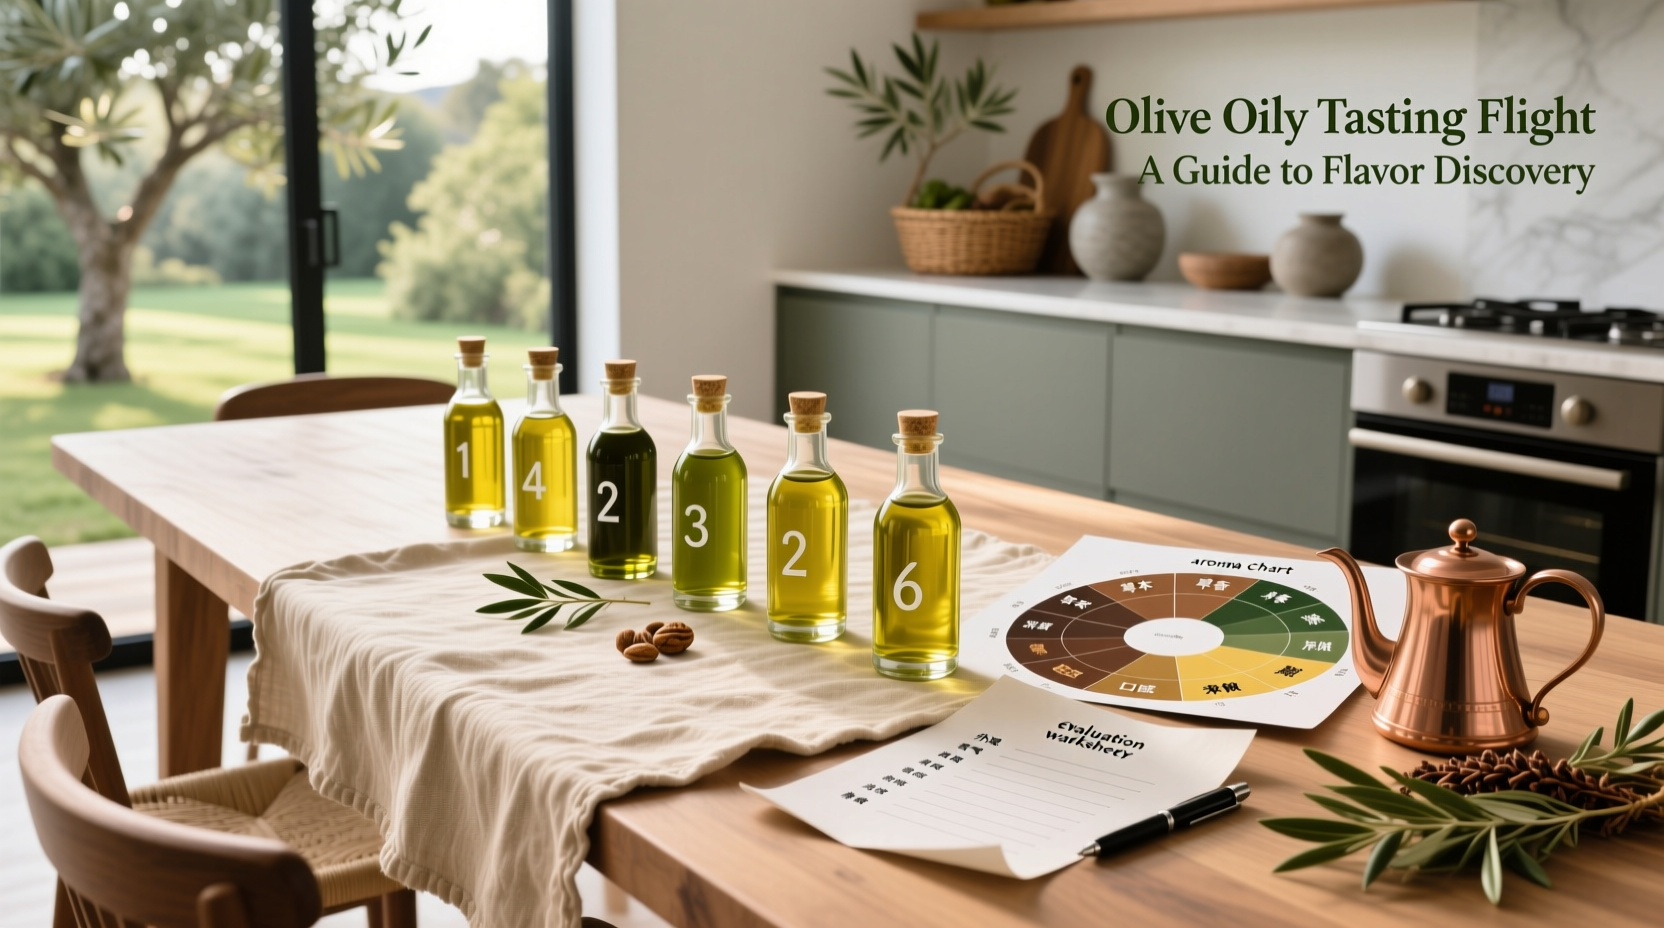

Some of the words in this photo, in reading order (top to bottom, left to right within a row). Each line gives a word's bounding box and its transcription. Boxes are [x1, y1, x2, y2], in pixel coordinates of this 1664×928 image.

[456, 442, 469, 478] 1
[522, 461, 546, 500] 4
[597, 481, 619, 523] 2
[684, 504, 709, 548] 3
[782, 530, 807, 577] 2
[893, 562, 923, 611] 6
